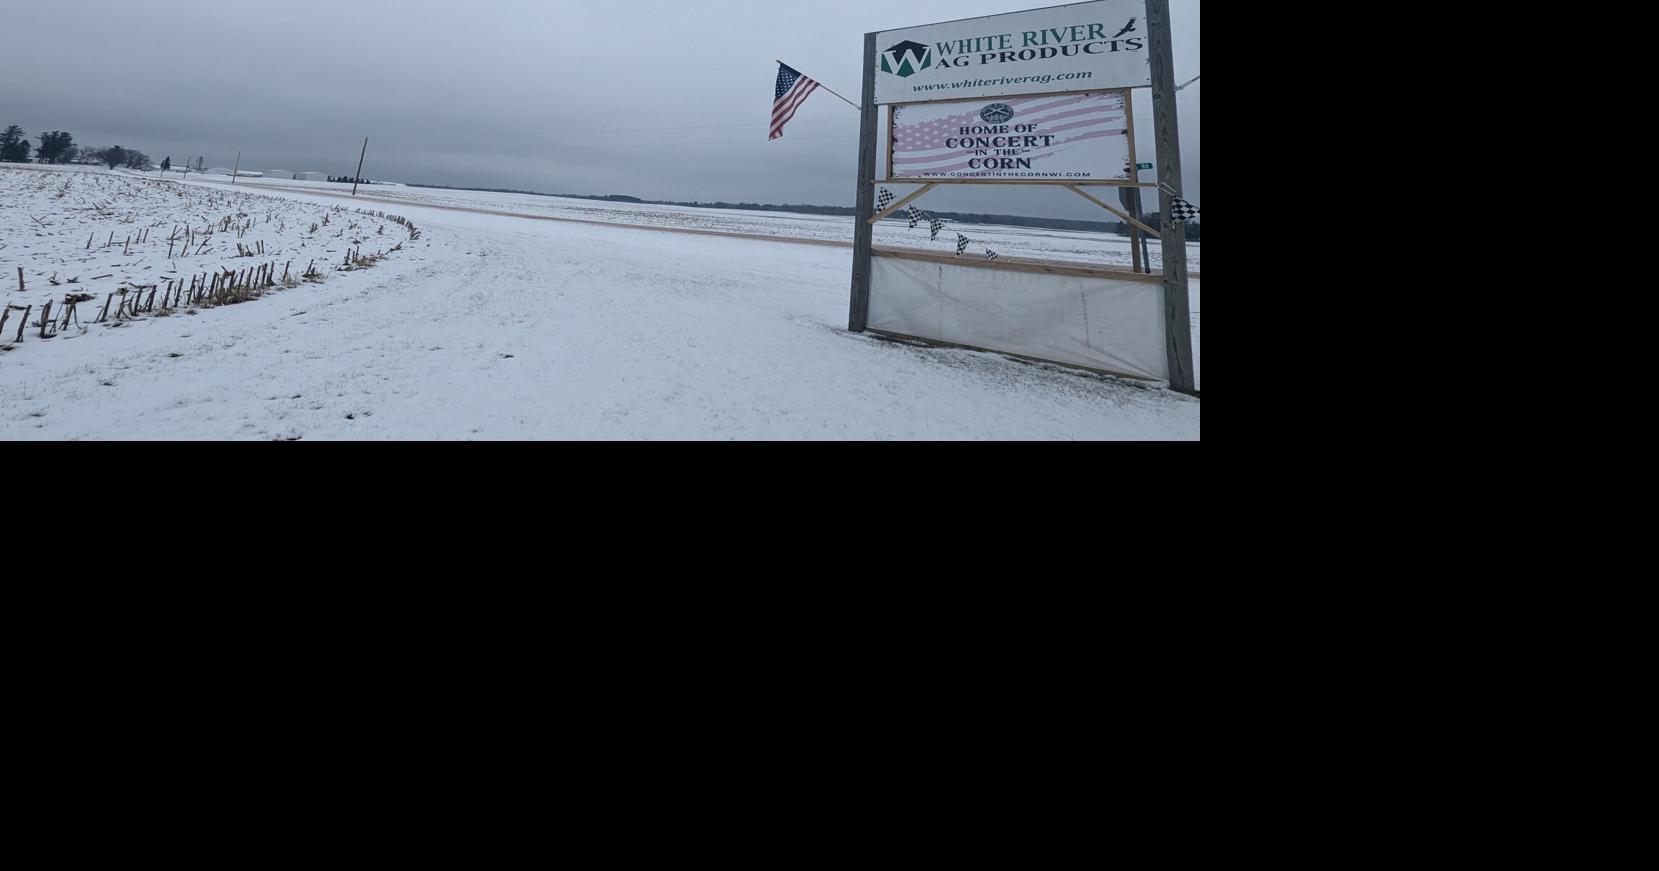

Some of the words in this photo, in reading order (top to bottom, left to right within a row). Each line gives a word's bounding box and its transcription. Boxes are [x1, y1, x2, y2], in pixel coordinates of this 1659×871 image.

[936, 34, 1013, 56] WHITE
[1021, 23, 1106, 47] RIVER
[881, 46, 931, 76] W
[935, 55, 970, 69] AG
[980, 38, 1143, 65] PRODUCTS
[913, 71, 1093, 92] www.whiteriverag.com
[960, 125, 1009, 135] HOME
[1014, 124, 1037, 133] OF
[945, 135, 1055, 149] CONCERT
[968, 157, 1031, 169] CORN
